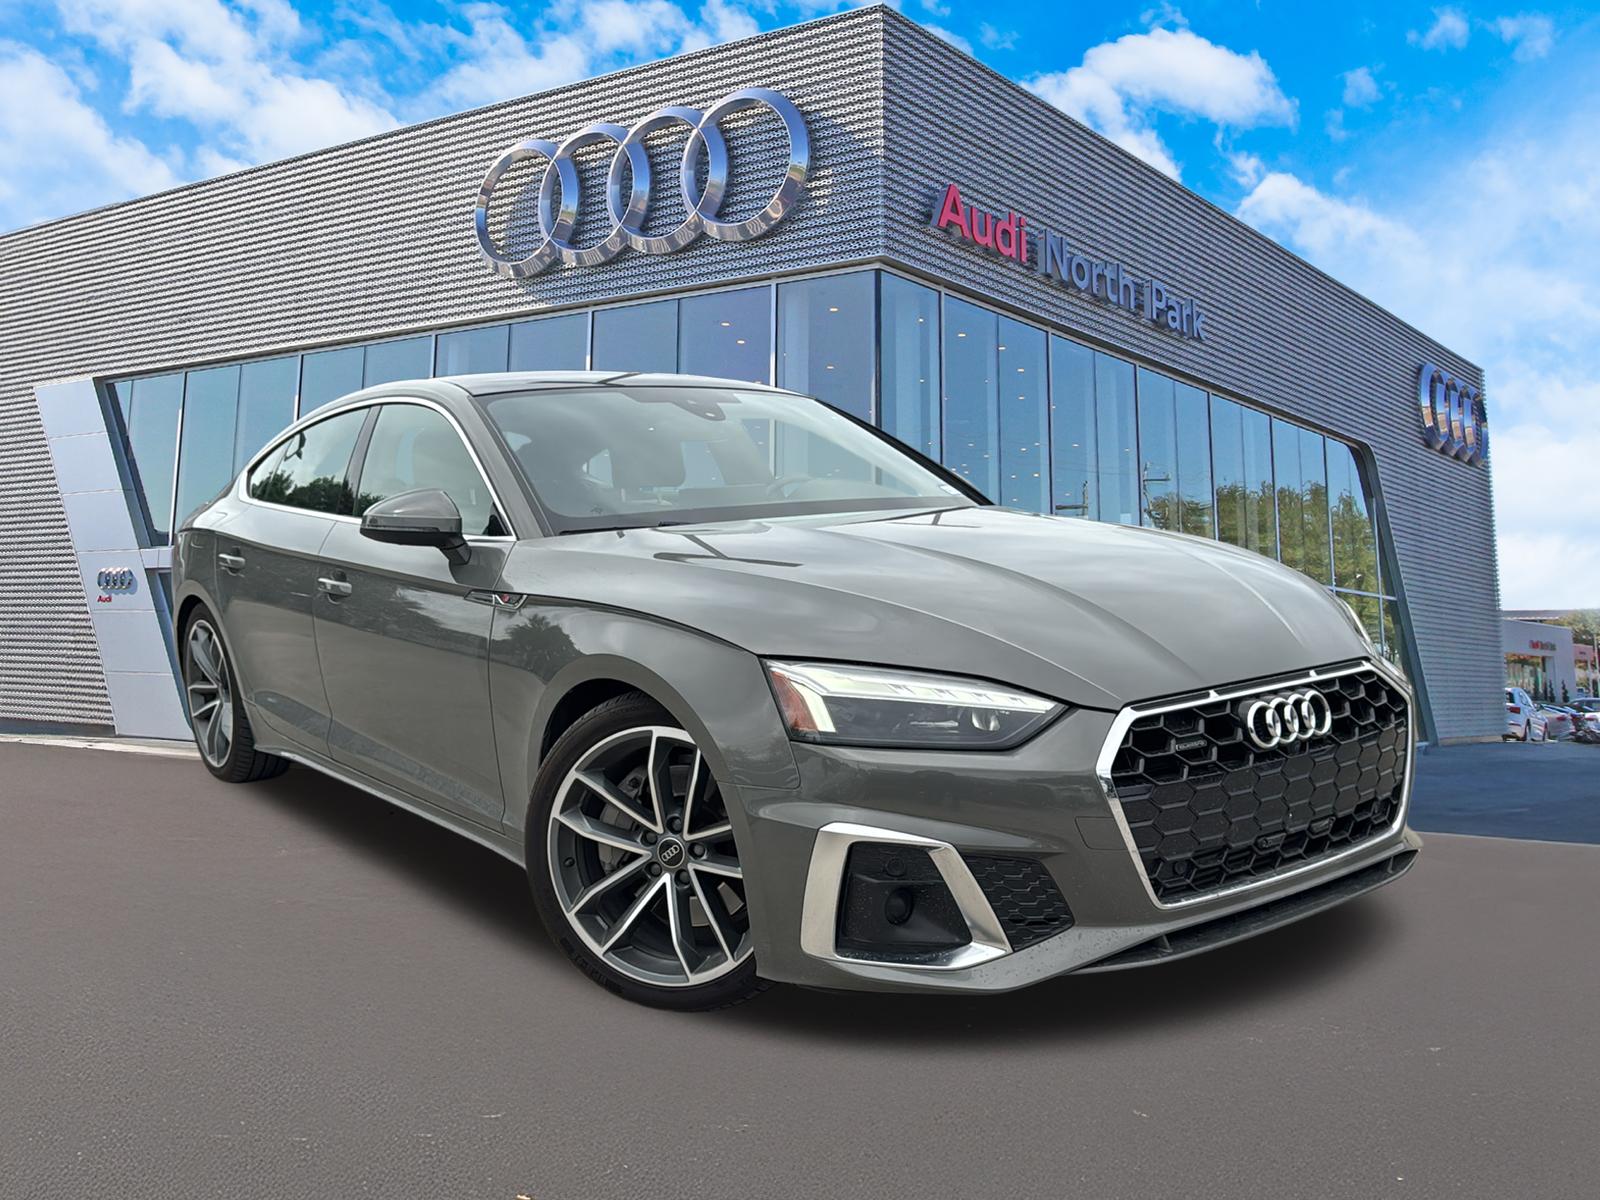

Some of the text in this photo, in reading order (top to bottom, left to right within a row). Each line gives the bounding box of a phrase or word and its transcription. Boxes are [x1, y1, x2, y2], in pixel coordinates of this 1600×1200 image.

[933, 183, 1206, 341] Audi North Park
